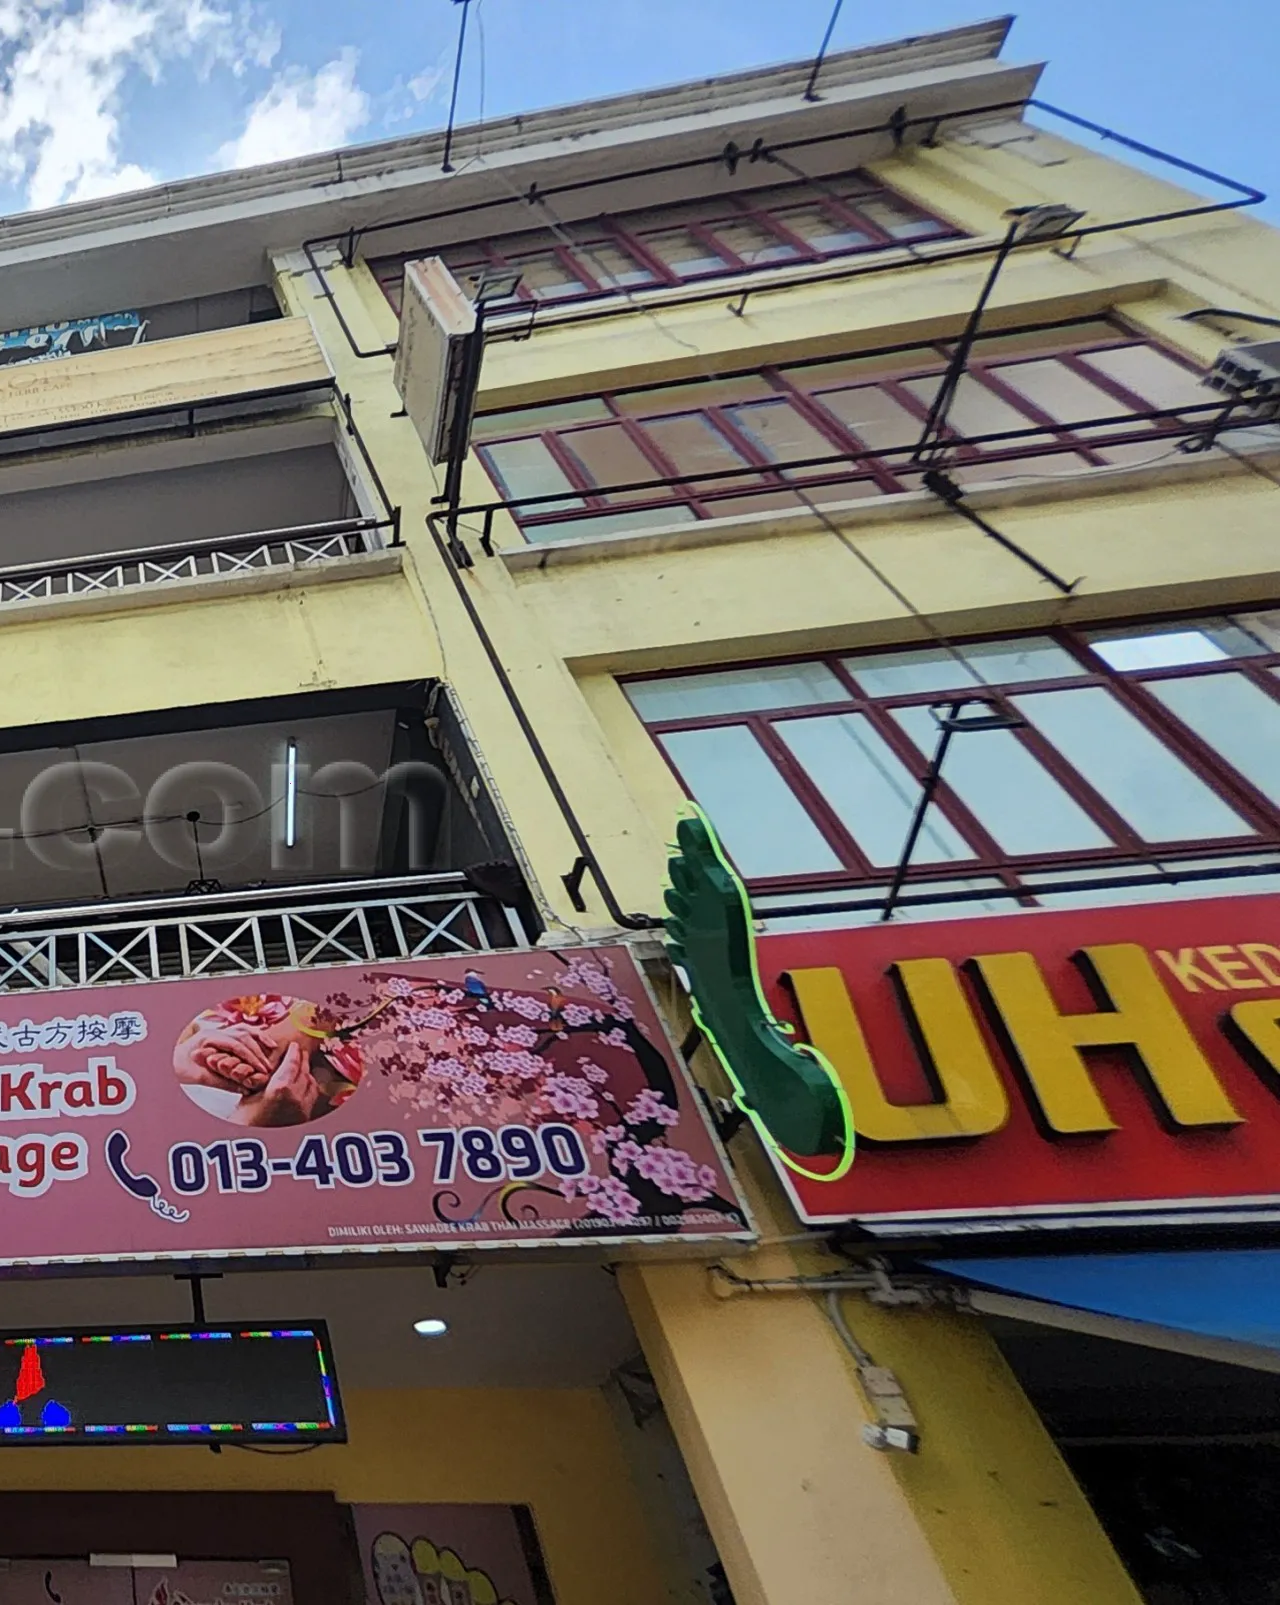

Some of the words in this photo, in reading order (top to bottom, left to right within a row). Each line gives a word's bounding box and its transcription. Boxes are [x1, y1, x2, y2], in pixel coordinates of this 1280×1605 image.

[780, 942, 1246, 1142] UH
[0, 1065, 128, 1112] Krab
[168, 1131, 413, 1196] 013-403
[417, 1122, 591, 1186] 7890
[327, 1224, 372, 1238] DIMILIKI
[373, 1223, 404, 1236] OLEH:
[405, 1221, 457, 1235] SAWADEE
